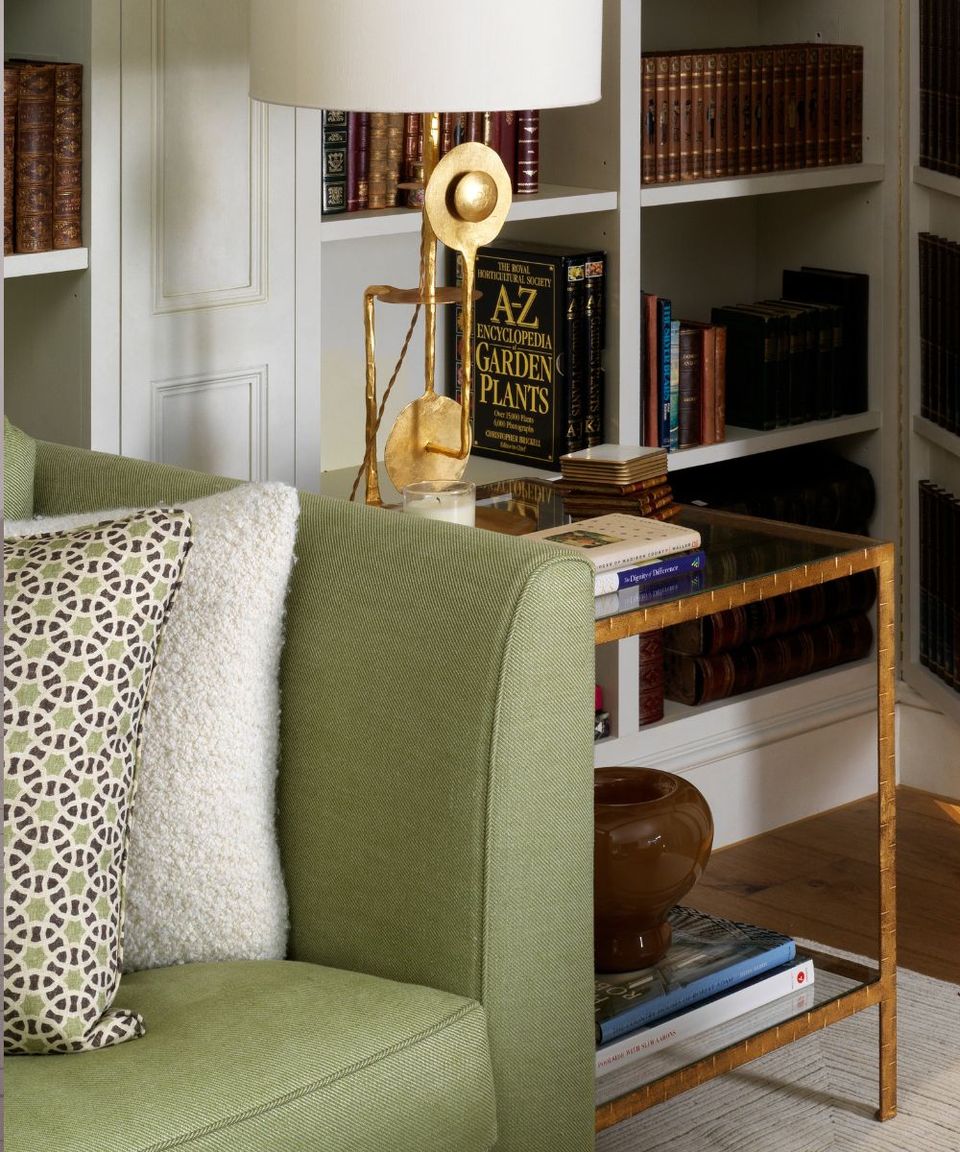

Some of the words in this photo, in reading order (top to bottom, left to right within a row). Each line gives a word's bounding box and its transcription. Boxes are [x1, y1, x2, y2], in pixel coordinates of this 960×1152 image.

[497, 261, 511, 272] THE
[511, 263, 531, 275] ROYAL
[477, 269, 526, 285] HORTICULTURAL
[526, 275, 552, 288] SOCIETY
[490, 284, 540, 329] A-Z
[663, 305, 671, 324] THE
[477, 323, 552, 350] ENCYCLOPEDIA
[475, 341, 553, 384] GARDEN
[479, 373, 549, 414] PLANTS
[493, 409, 506, 418] Over
[630, 572, 649, 584] Dignity
[652, 565, 679, 577] Difference
